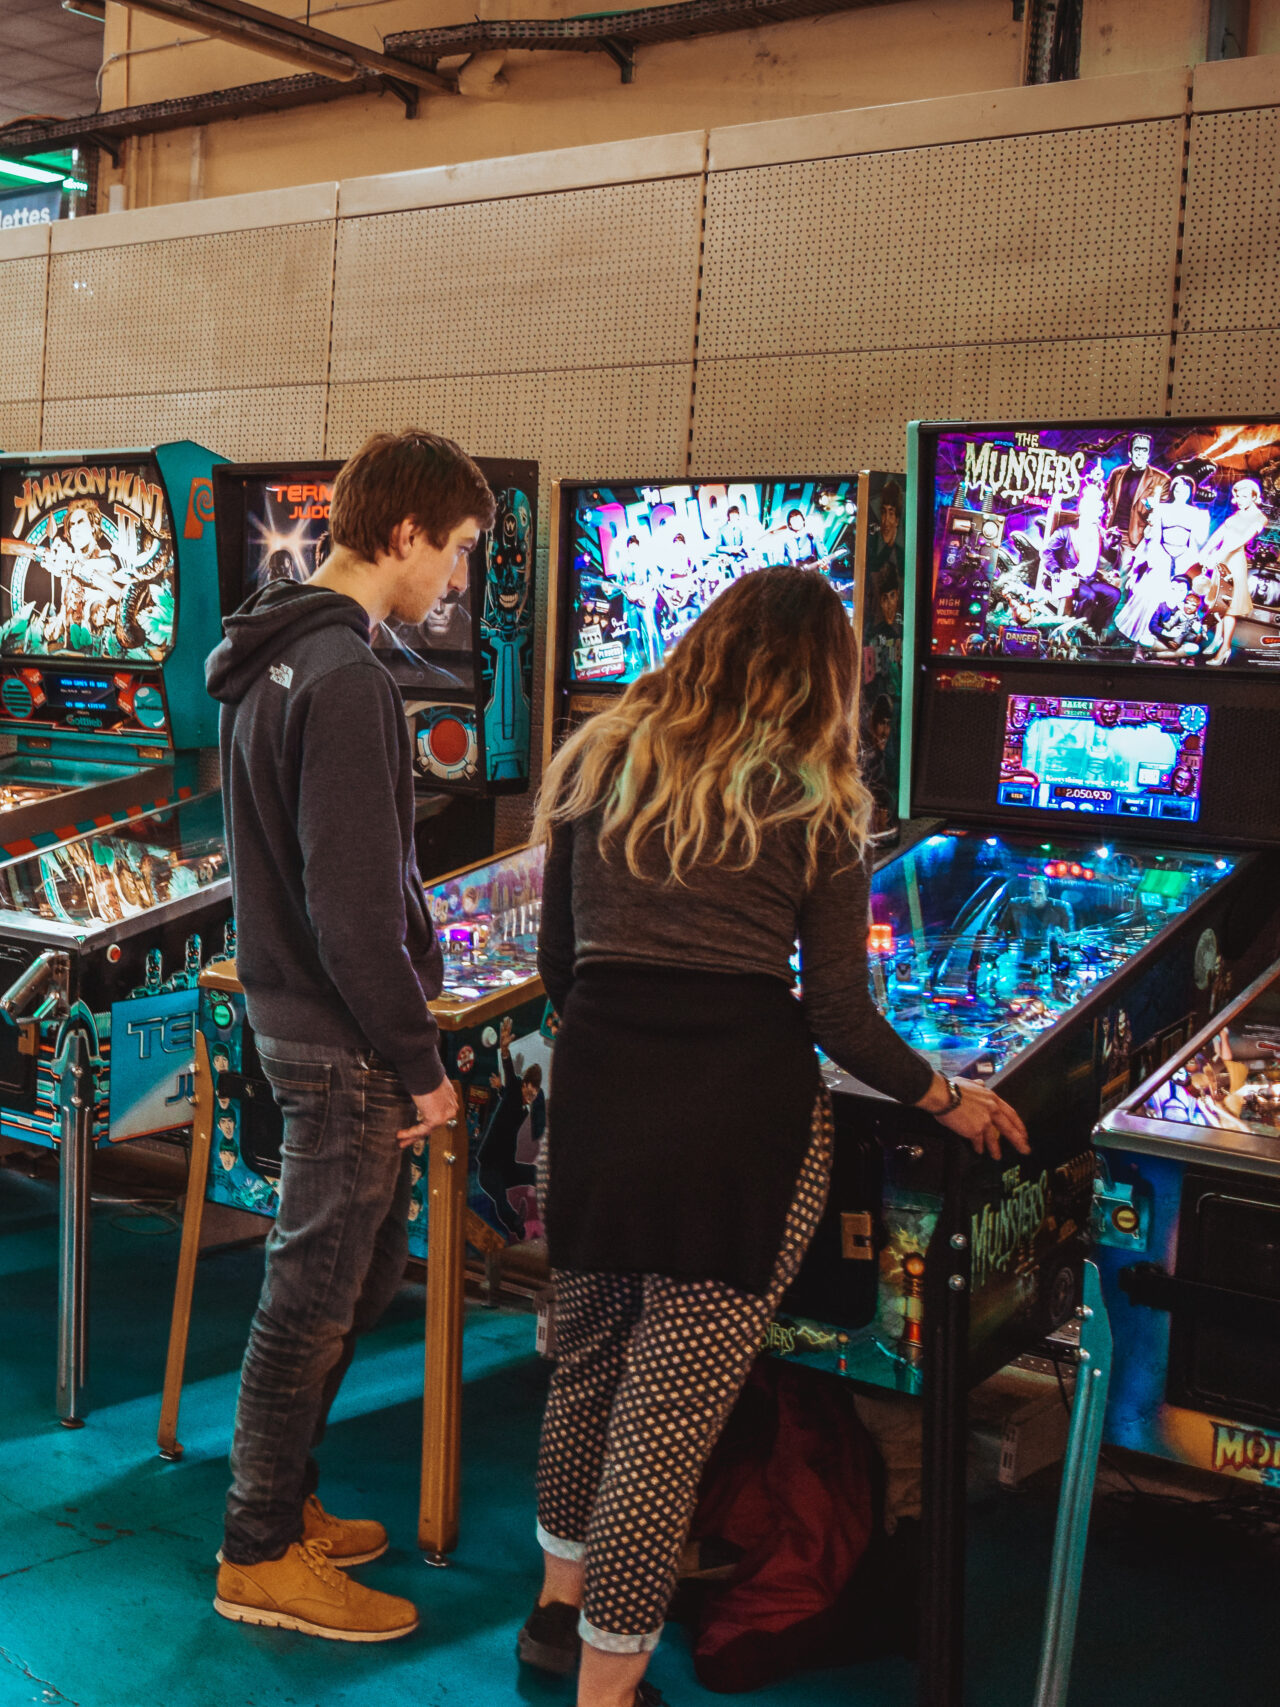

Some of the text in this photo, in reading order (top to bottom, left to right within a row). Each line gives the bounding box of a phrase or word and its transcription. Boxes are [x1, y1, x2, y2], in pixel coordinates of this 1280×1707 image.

[1015, 432, 1039, 448] THE
[964, 441, 1085, 505] MUNSTERS
[12, 466, 164, 538] AMAZON HUNT
[1005, 632, 1038, 643] DANGER
[66, 714, 102, 728] Gottlieb
[970, 1169, 1048, 1292] MUNSTERS
